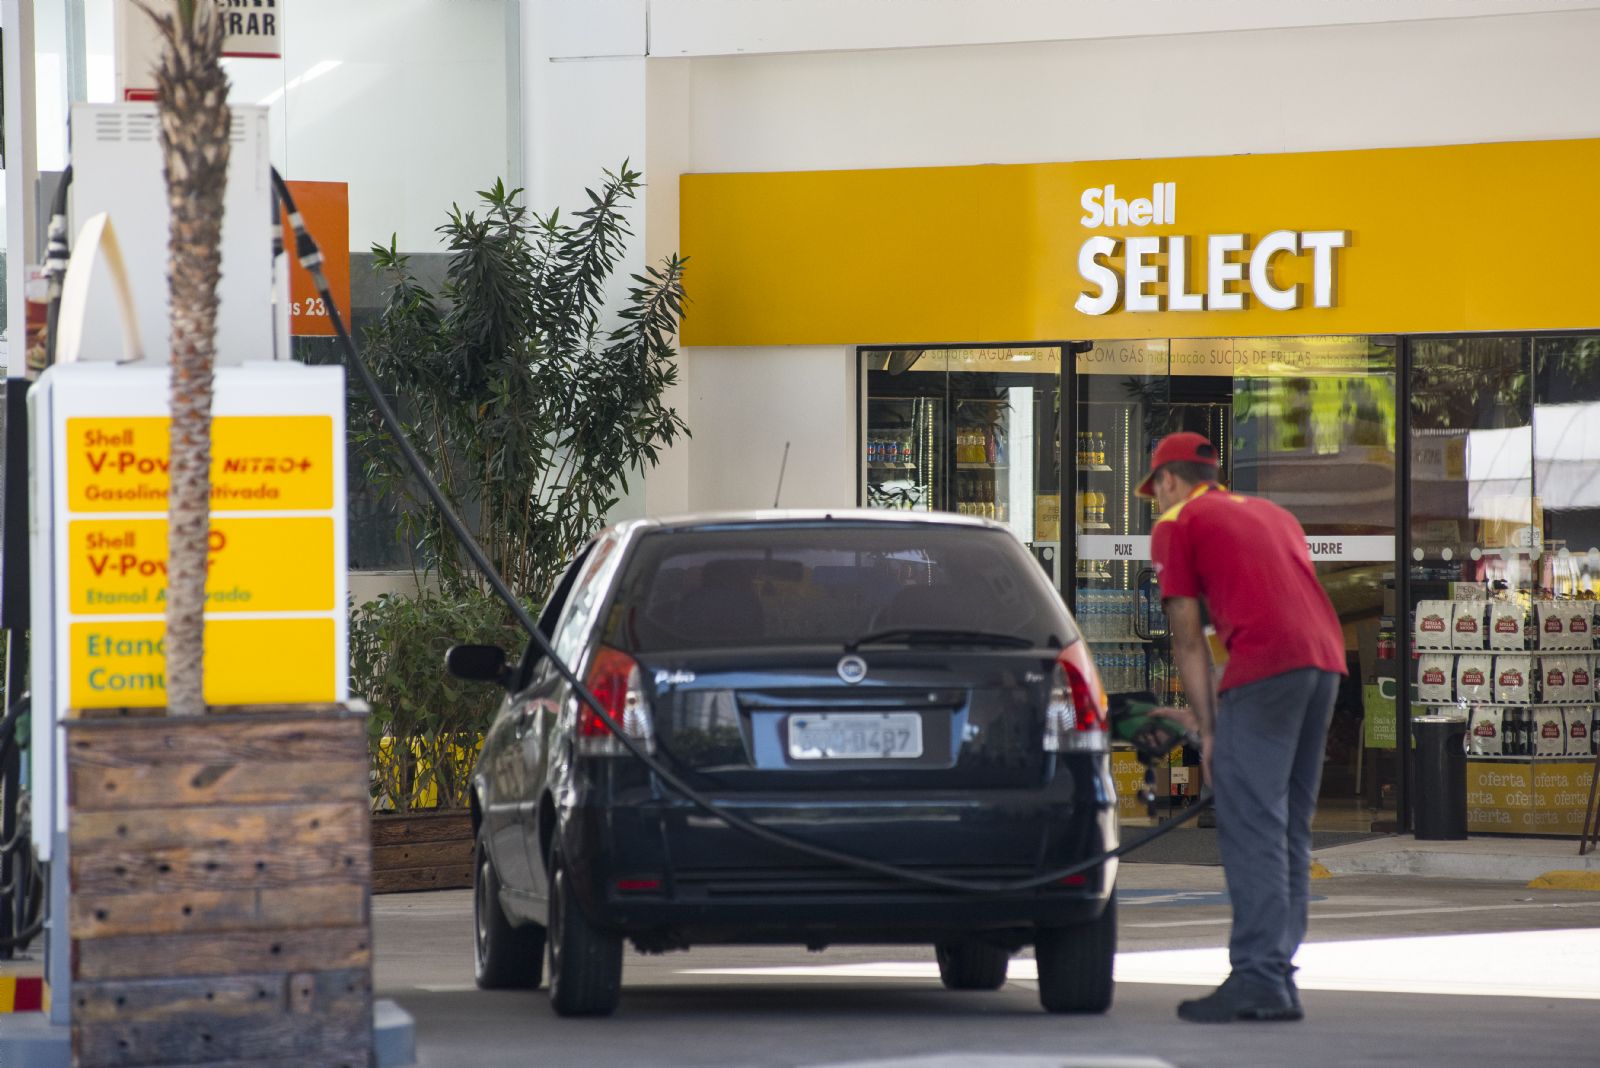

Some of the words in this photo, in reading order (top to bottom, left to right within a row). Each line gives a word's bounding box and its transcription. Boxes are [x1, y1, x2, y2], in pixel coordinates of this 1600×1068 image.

[1080, 182, 1176, 228] Shell
[1074, 229, 1348, 315] SELECT
[1087, 348, 1116, 363] COM
[1210, 350, 1249, 365] SUCOS
[1252, 350, 1267, 365] DE
[84, 429, 134, 447] Shell
[86, 451, 170, 475] V-Po
[86, 531, 136, 549] Shell
[1114, 543, 1133, 556] PUXE
[88, 554, 214, 577] V-Por
[86, 585, 148, 604] Etanol
[87, 633, 165, 657] Etan
[88, 666, 166, 691] Com
[1478, 771, 1526, 788] oferta
[1534, 772, 1569, 787] oferta
[1554, 790, 1588, 806] oferta
